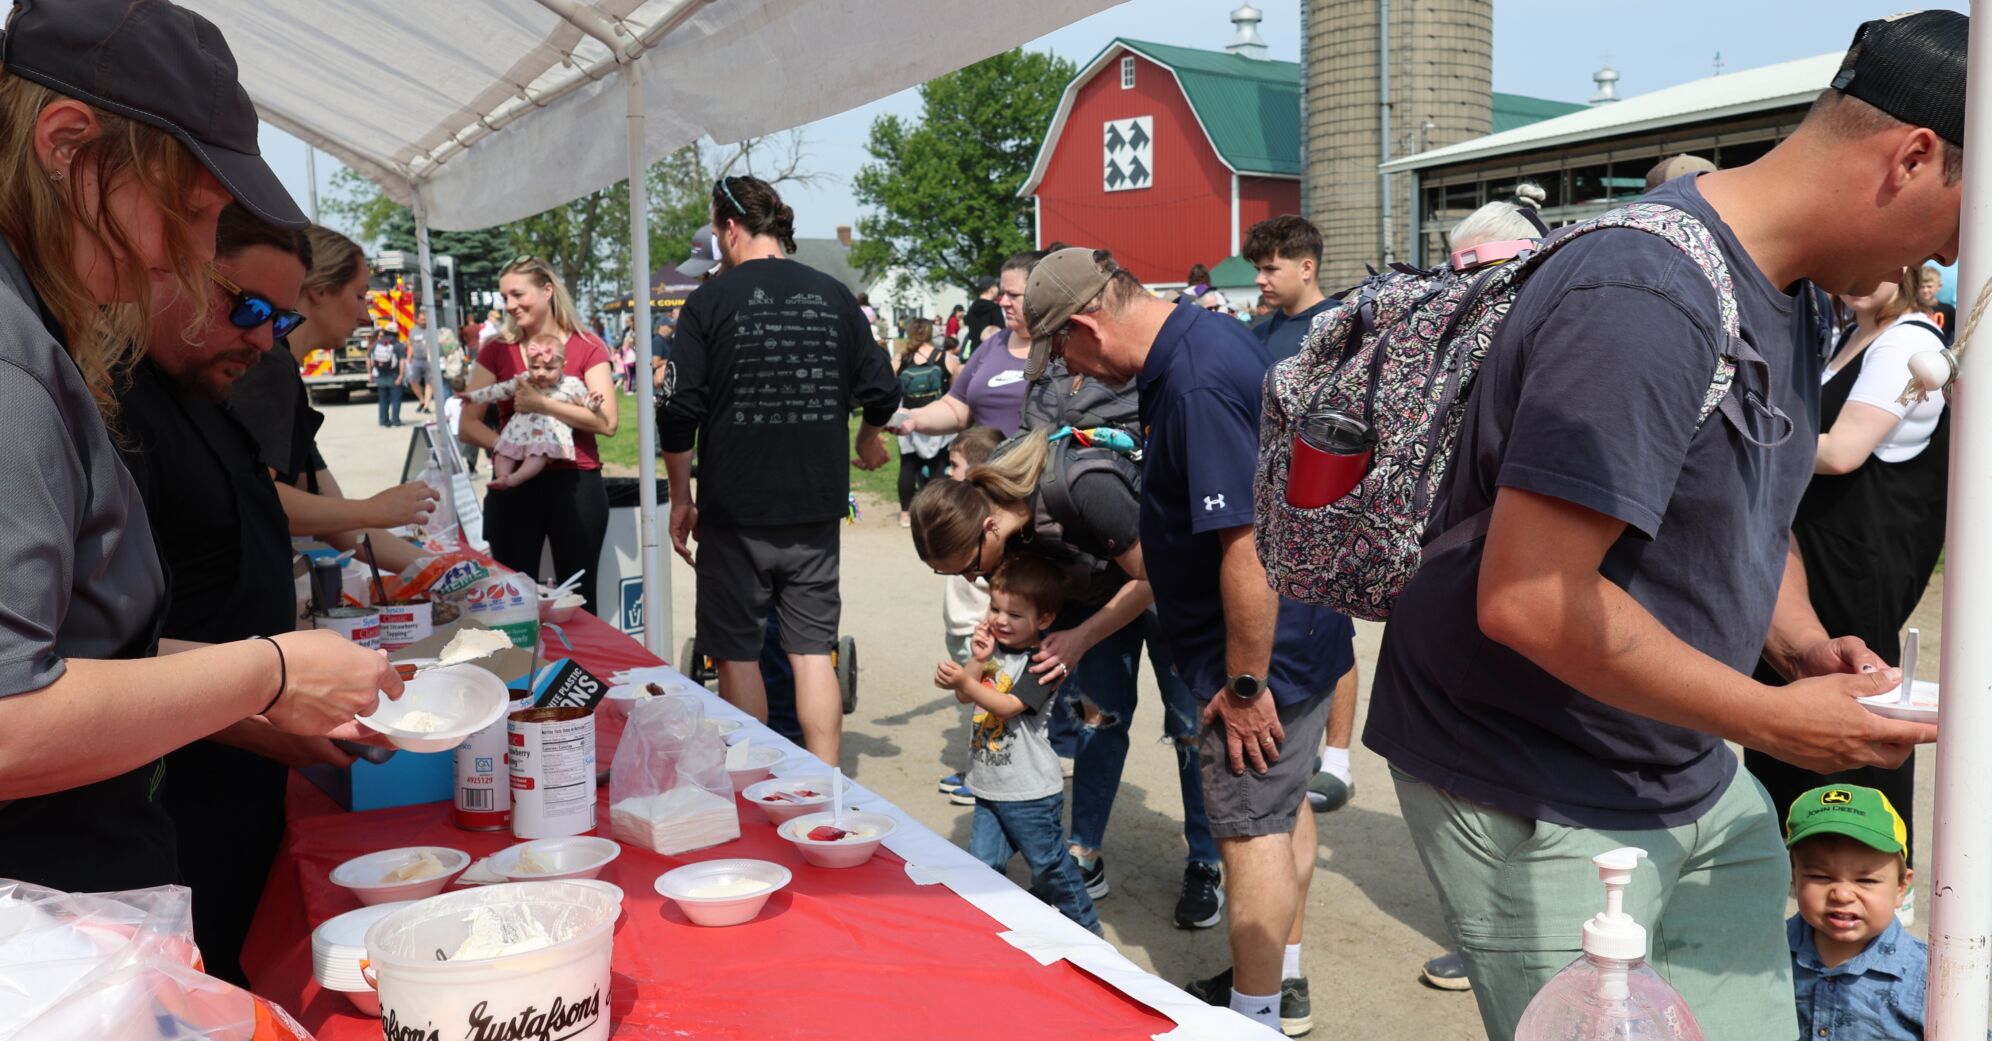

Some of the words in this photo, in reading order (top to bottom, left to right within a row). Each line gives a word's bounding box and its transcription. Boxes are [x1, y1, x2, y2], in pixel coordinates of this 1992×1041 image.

[657, 299, 686, 307] COUN
[559, 668, 582, 695] PLASTIC
[1806, 806, 1831, 818] JOHN
[1831, 805, 1867, 817] DEERE
